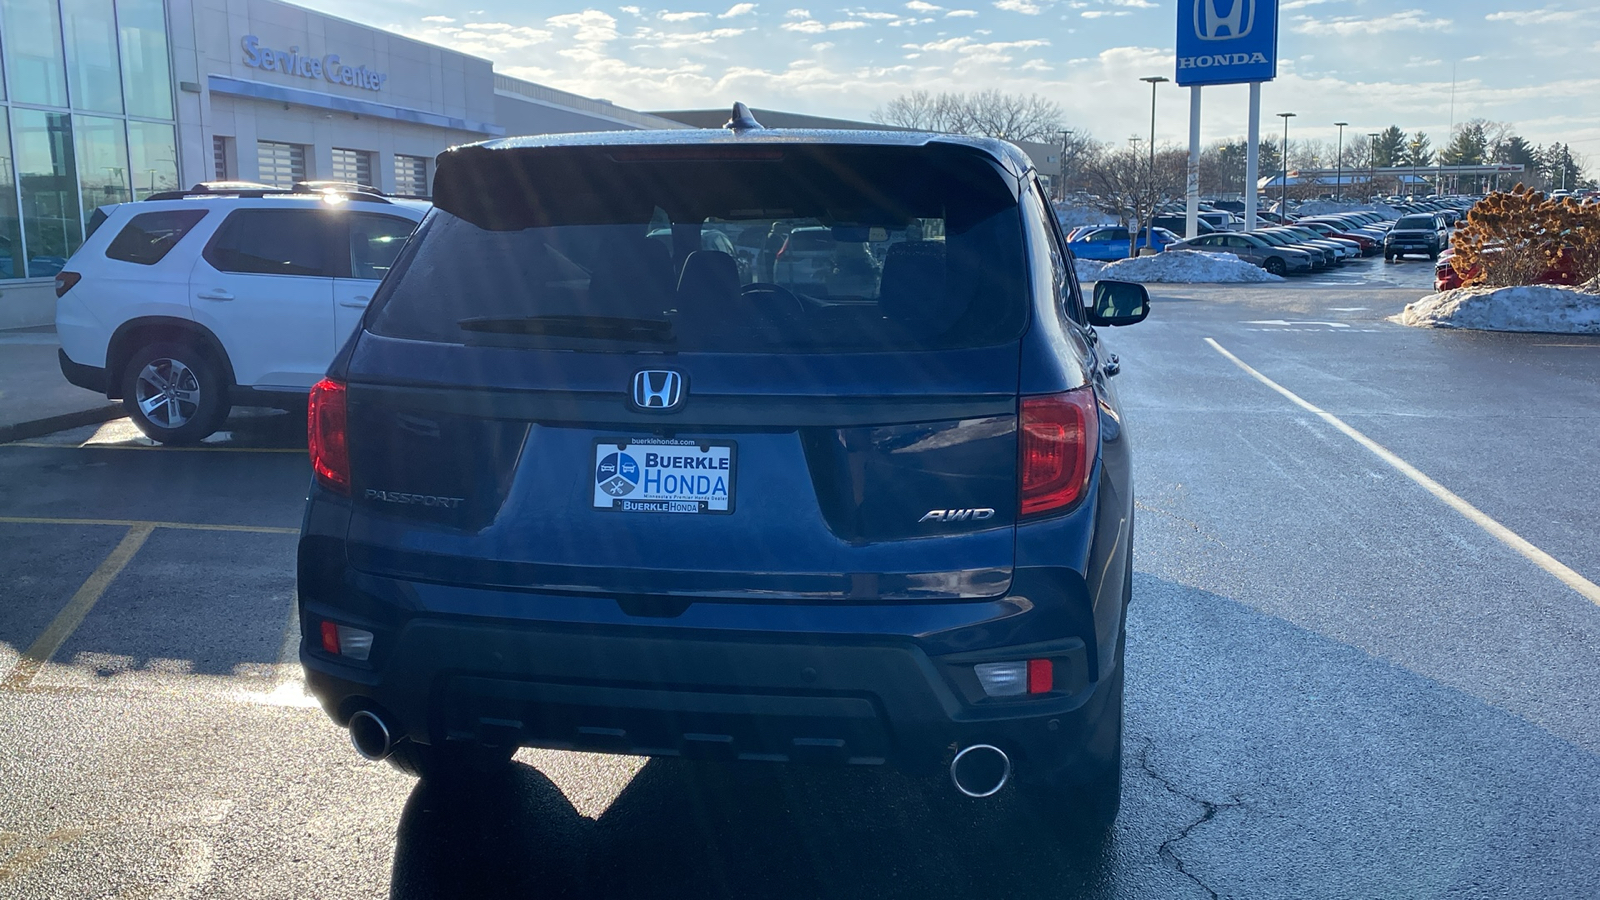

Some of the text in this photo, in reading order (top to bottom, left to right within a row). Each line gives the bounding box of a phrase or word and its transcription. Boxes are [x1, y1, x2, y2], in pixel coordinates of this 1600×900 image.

[241, 35, 387, 91] Service Center
[1178, 52, 1269, 69] HONDA
[631, 438, 695, 446] buerklehonda.com
[645, 453, 729, 470] BUERKLE
[644, 469, 727, 496] HONDA
[364, 488, 465, 508] PASSPORT
[623, 501, 697, 512] BUERKLE HONDA
[918, 508, 995, 522] AWD
